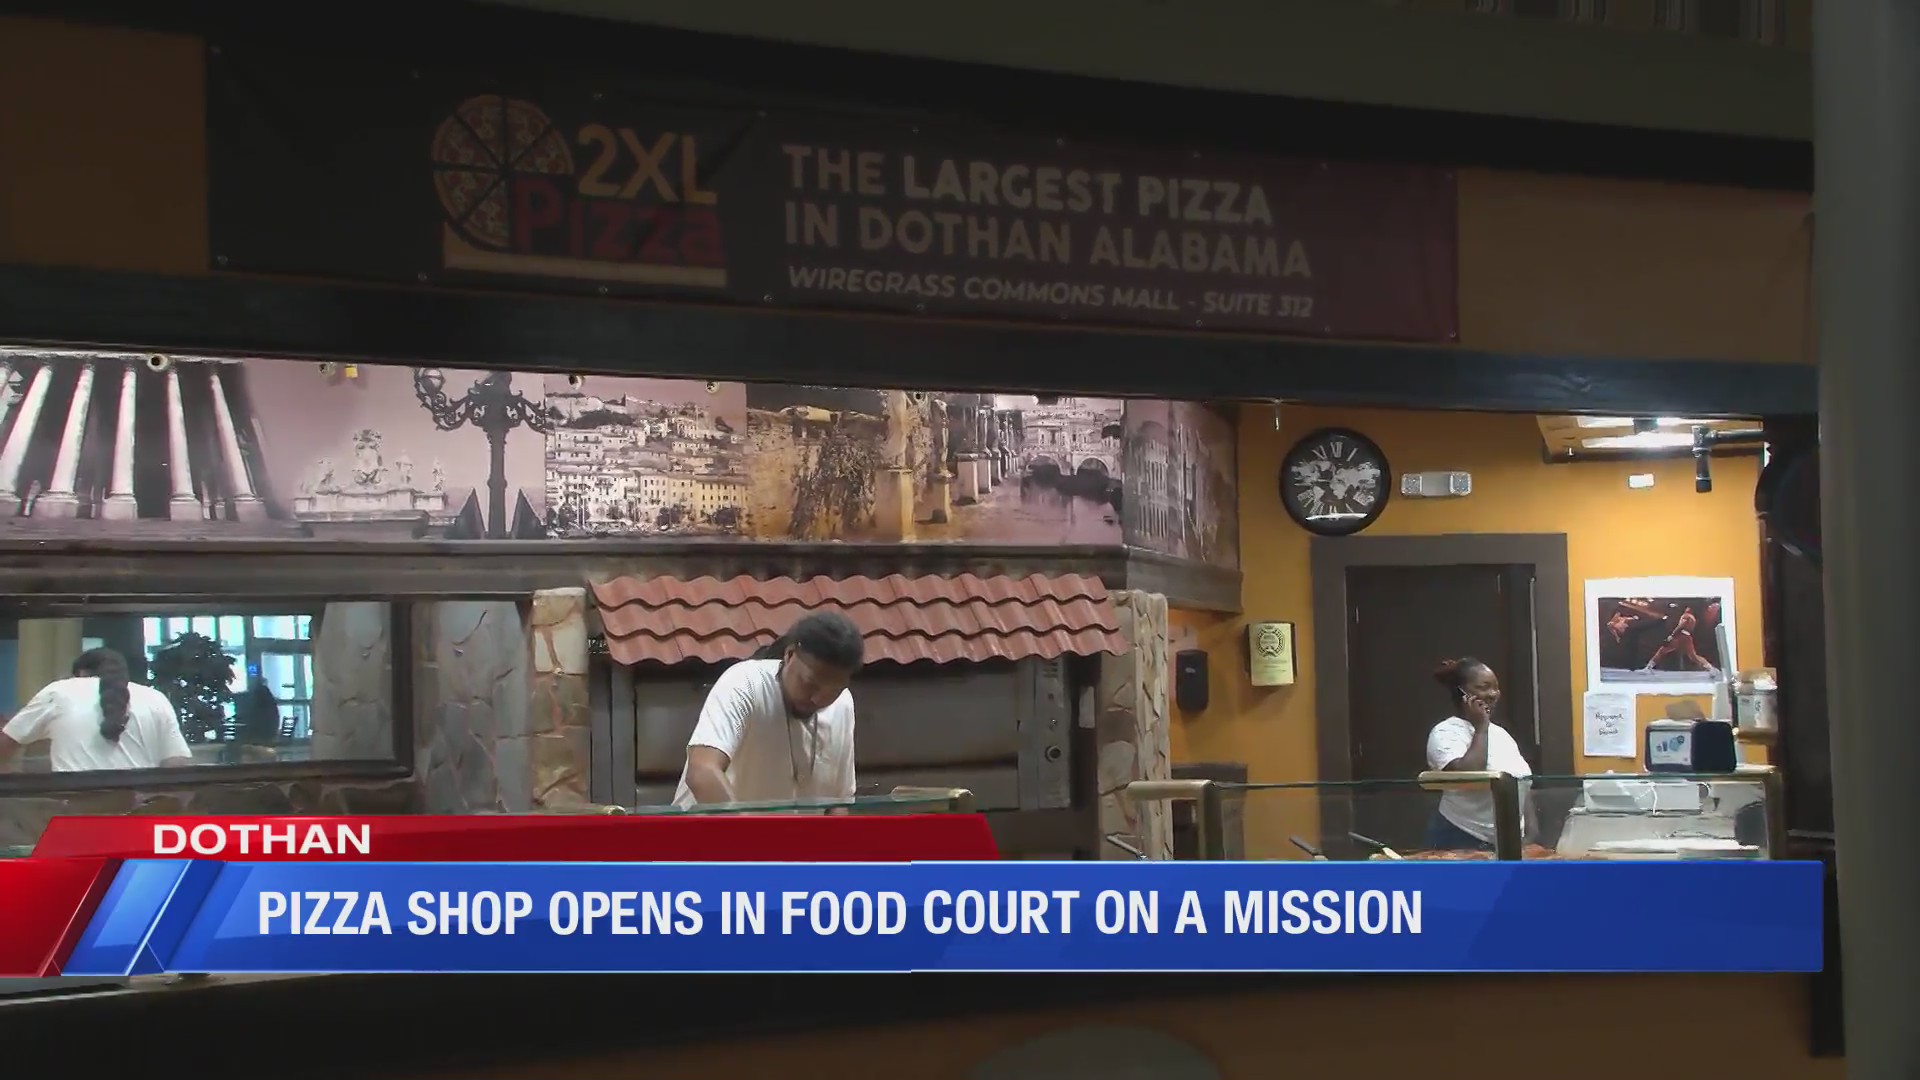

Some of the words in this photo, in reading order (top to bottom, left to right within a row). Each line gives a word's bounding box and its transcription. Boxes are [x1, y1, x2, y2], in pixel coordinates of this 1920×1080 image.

[577, 121, 718, 206] 2XL
[782, 145, 886, 196] THE
[903, 155, 1122, 214] LARGEST
[1137, 175, 1274, 226] PIZZA
[513, 176, 726, 266] Pizza
[784, 200, 839, 248] IN
[859, 205, 1072, 265] DOTHAN
[1089, 225, 1312, 279] ALABAMA
[788, 264, 956, 298] WIREGRASS
[963, 275, 1106, 308] COMMONS
[1111, 286, 1180, 311] MALL
[1202, 290, 1272, 316] SUITE
[1276, 294, 1314, 318] 312
